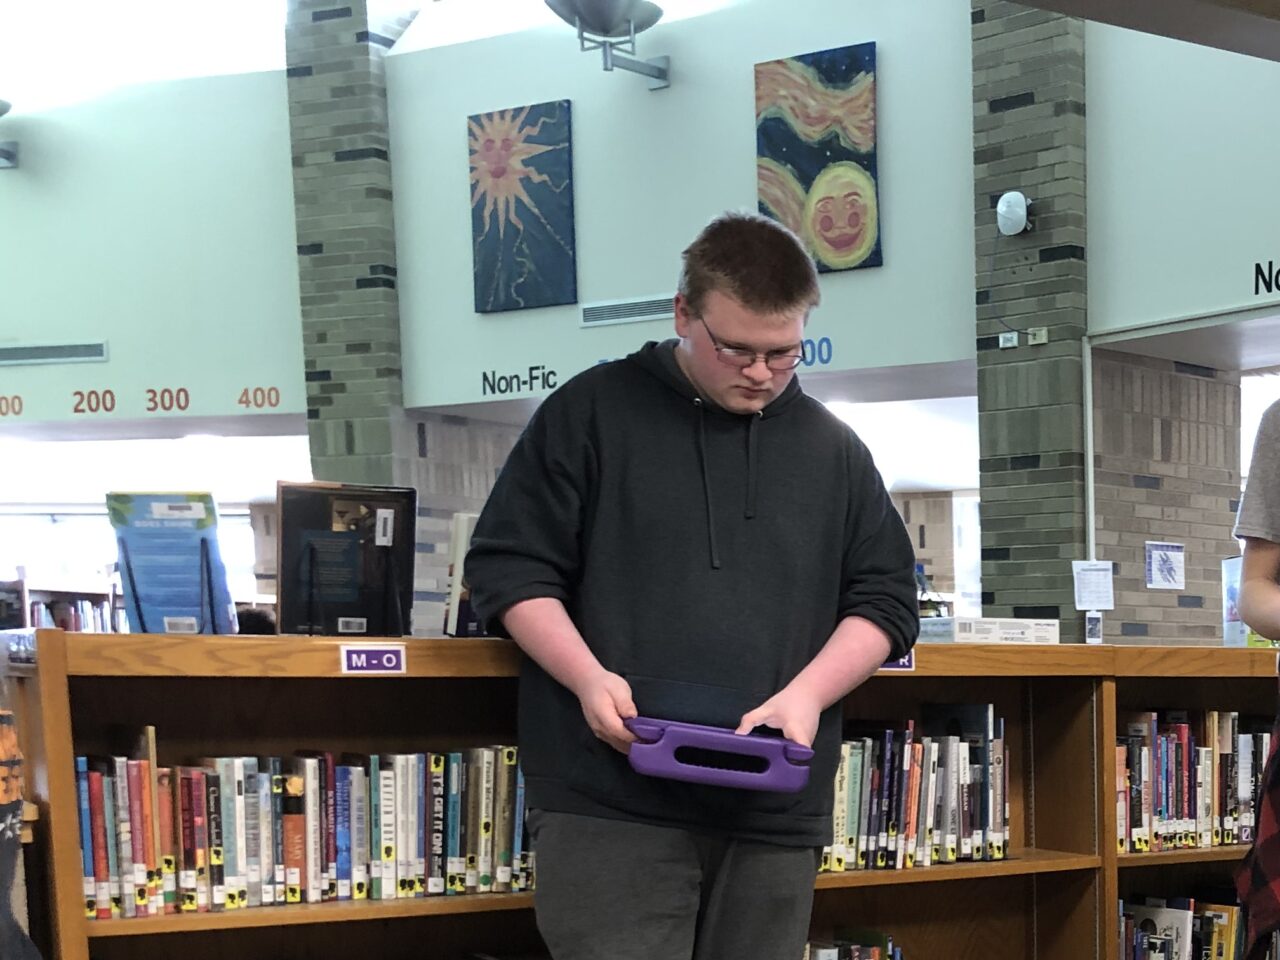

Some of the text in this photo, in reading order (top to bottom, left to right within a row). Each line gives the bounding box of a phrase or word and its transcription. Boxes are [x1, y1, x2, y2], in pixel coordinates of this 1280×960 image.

[802, 338, 833, 367] 00
[482, 366, 558, 395] Non-Fic
[0, 395, 23, 416] 00
[73, 389, 116, 413] 200
[146, 388, 190, 411] 300
[238, 387, 280, 409] 400
[351, 653, 367, 667] M
[382, 653, 397, 668] O
[433, 798, 443, 818] GET
[434, 820, 443, 831] IT
[432, 833, 443, 854] ON!
